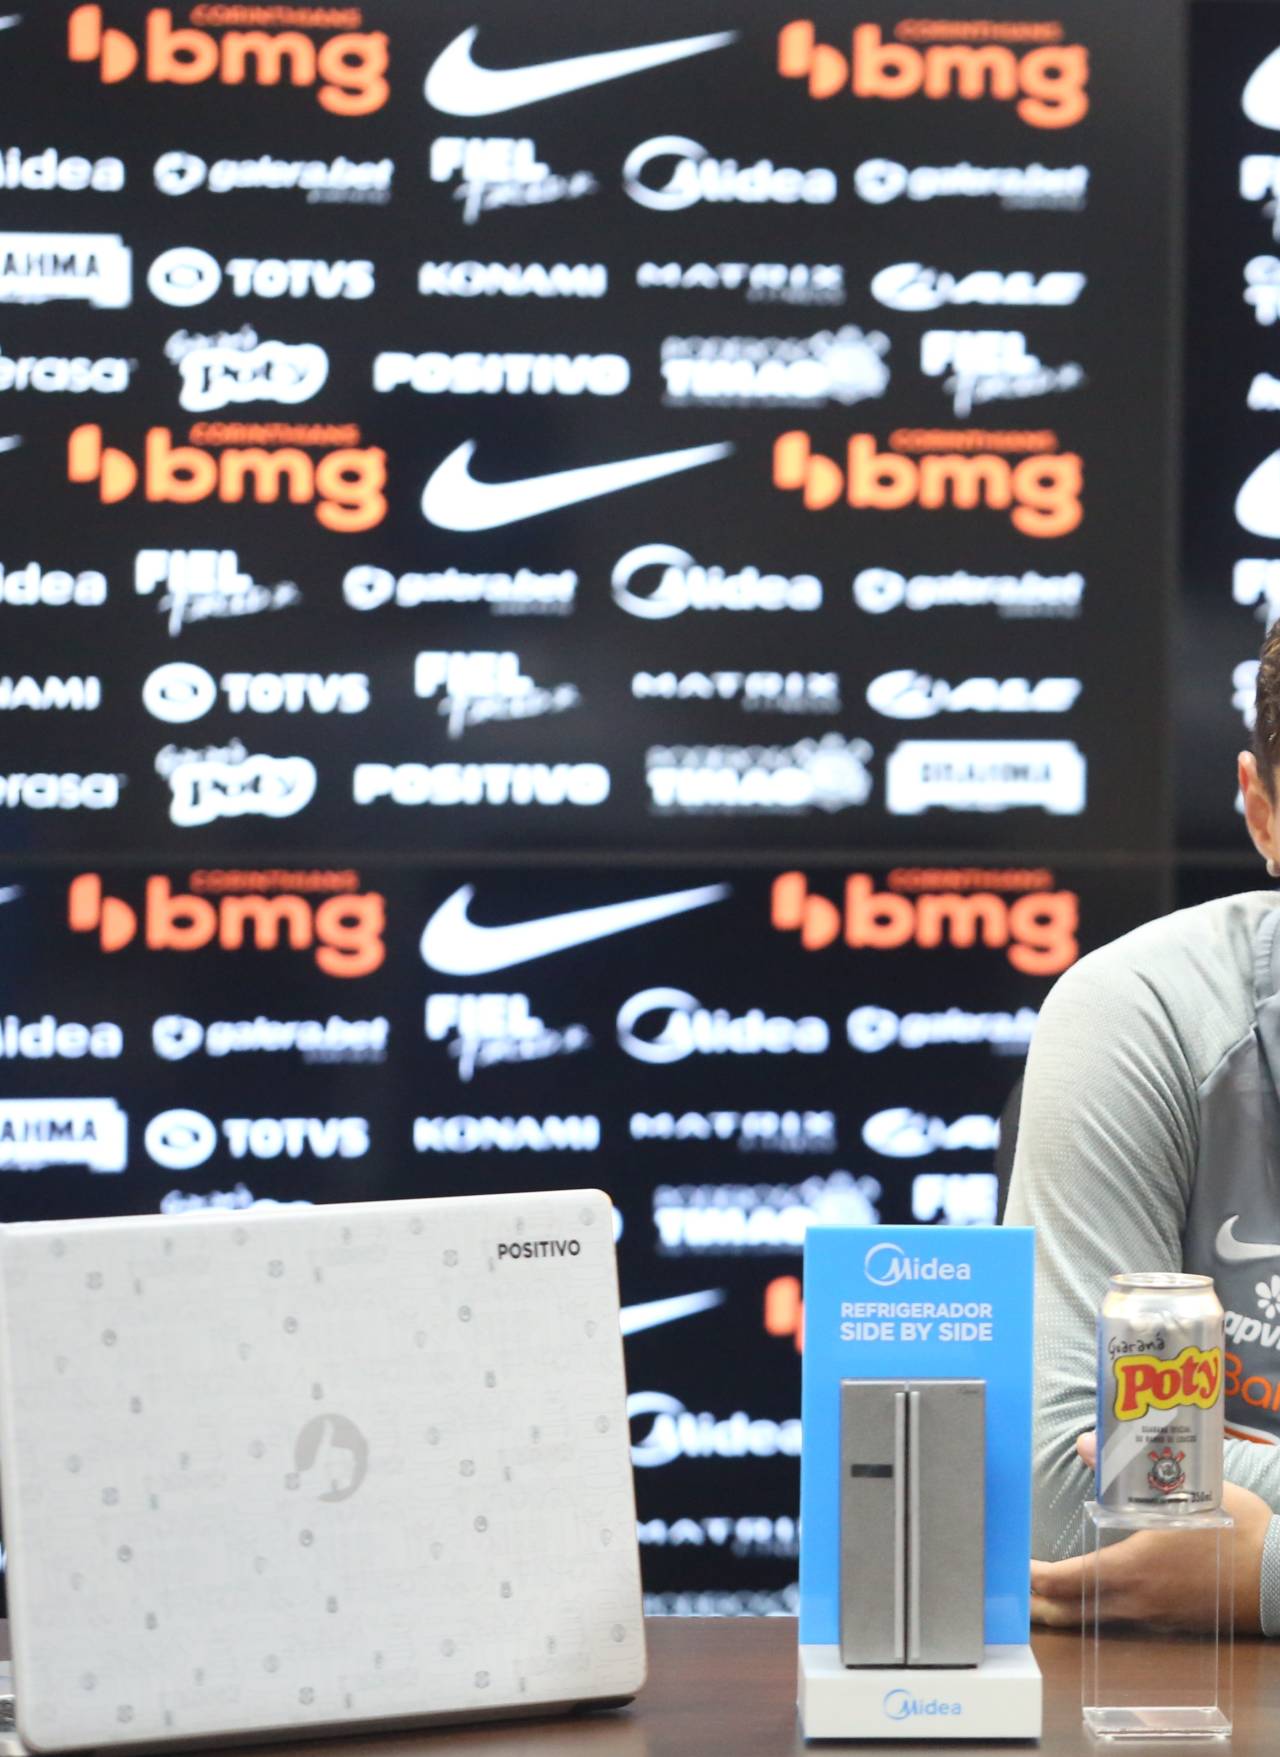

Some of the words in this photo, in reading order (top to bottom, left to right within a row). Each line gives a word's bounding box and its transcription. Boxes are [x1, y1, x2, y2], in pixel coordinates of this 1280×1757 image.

[145, 5, 392, 118] bmg
[851, 22, 1090, 131] bmg
[0, 146, 126, 192] idea
[224, 257, 376, 300] TOTVS
[417, 260, 609, 299] KONAMI
[372, 351, 632, 397] POSITIVO
[145, 426, 390, 533] bmg
[845, 433, 1086, 539] bmg
[0, 560, 110, 608] dea
[219, 671, 372, 715] TOTVS
[352, 761, 612, 807] POSITIVO
[145, 875, 388, 979] bmg
[844, 873, 1081, 976] bmg
[0, 1014, 124, 1060] idea
[221, 1116, 371, 1160] TOTVS
[412, 1114, 601, 1153] KONAMI
[498, 1240, 581, 1261] POSITIVO
[889, 1257, 971, 1282] Midea
[840, 1302, 993, 1319] REFRIGERADOR
[840, 1322, 895, 1342] SIDE
[900, 1322, 930, 1343] BY
[937, 1322, 993, 1342] SIDE
[1120, 1353, 1220, 1412] Poty
